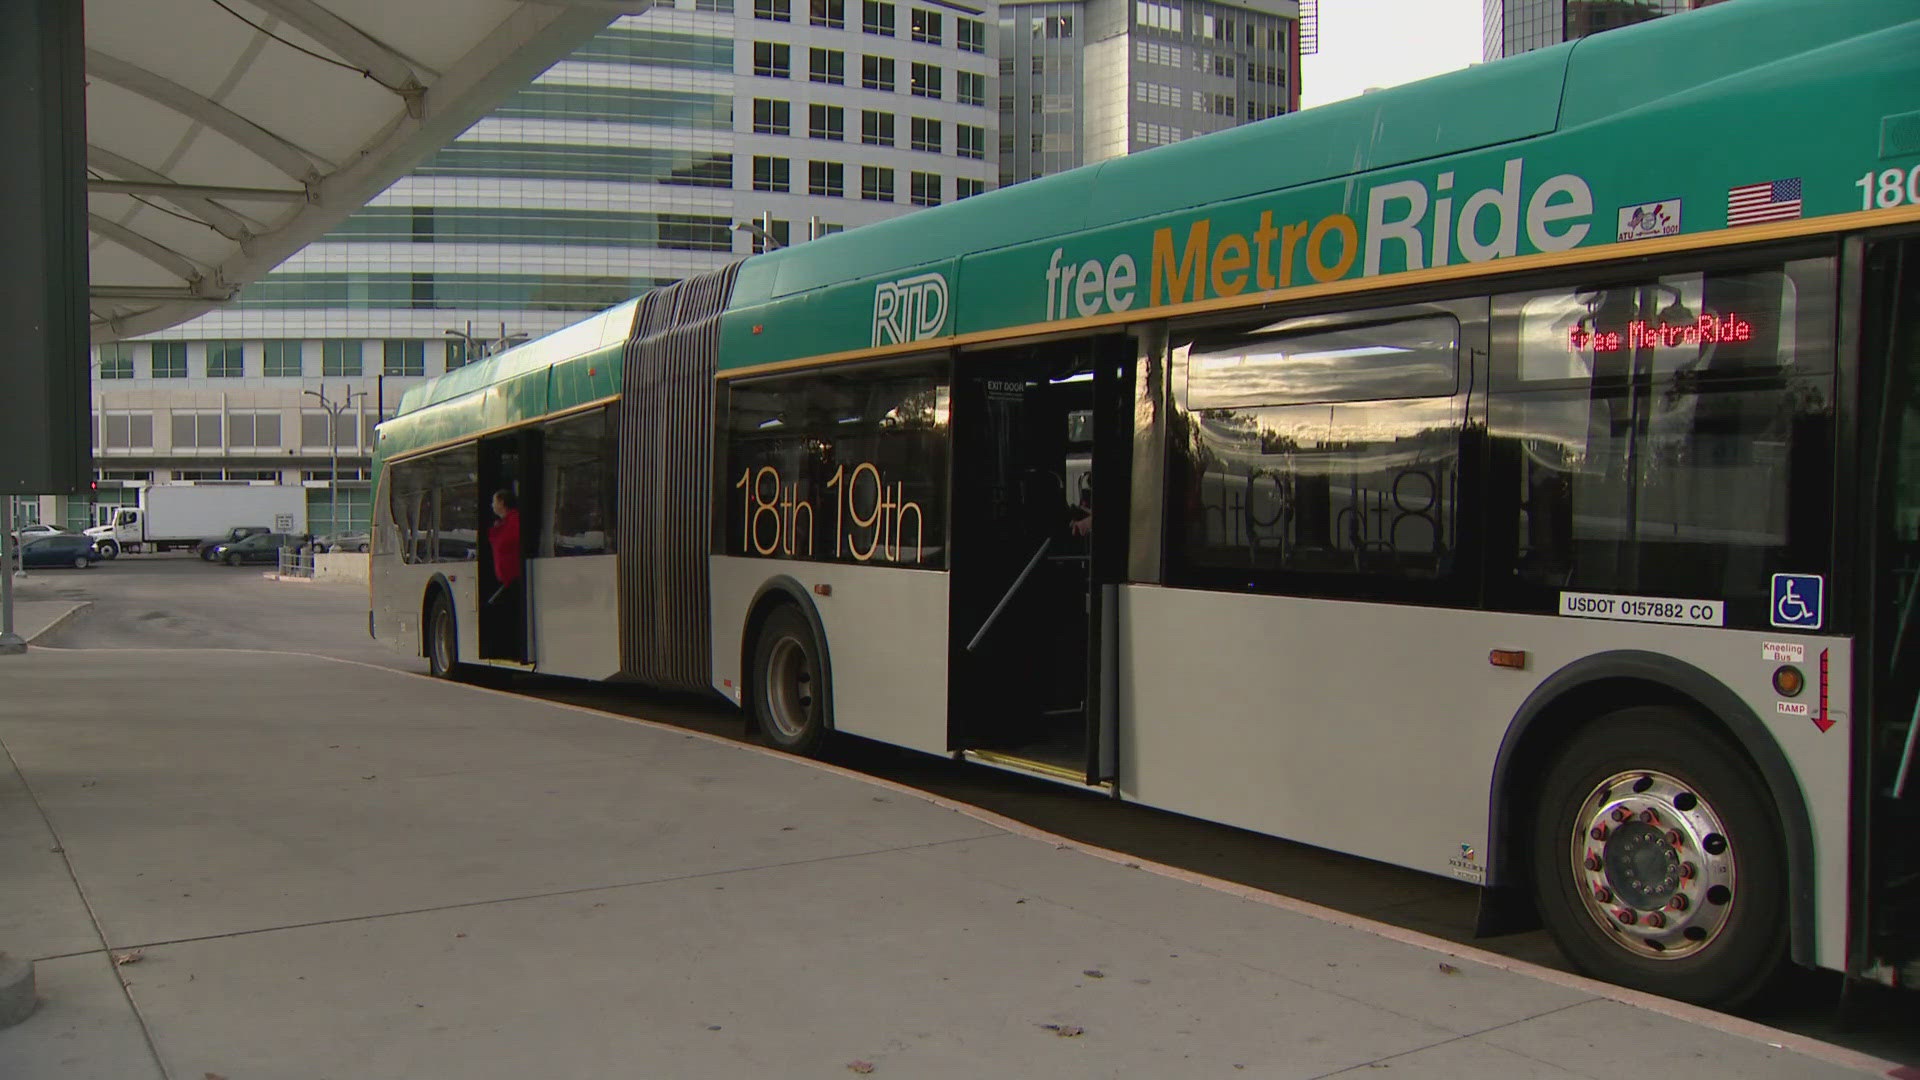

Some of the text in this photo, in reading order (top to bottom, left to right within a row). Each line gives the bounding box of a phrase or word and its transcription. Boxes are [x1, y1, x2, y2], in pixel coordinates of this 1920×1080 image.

[1619, 225, 1679, 240] ATU 1001
[1045, 247, 1137, 322] free
[871, 273, 949, 347] RTD
[1567, 312, 1751, 353] Free MetroRide
[987, 380, 1024, 392] EXIT DOOR
[736, 462, 923, 564] 18th 19th
[1567, 597, 1713, 620] USDOT 0157882 CO
[1763, 643, 1802, 655] Kneeling
[1774, 652, 1791, 661] Bus
[1778, 703, 1805, 713] RAMP
